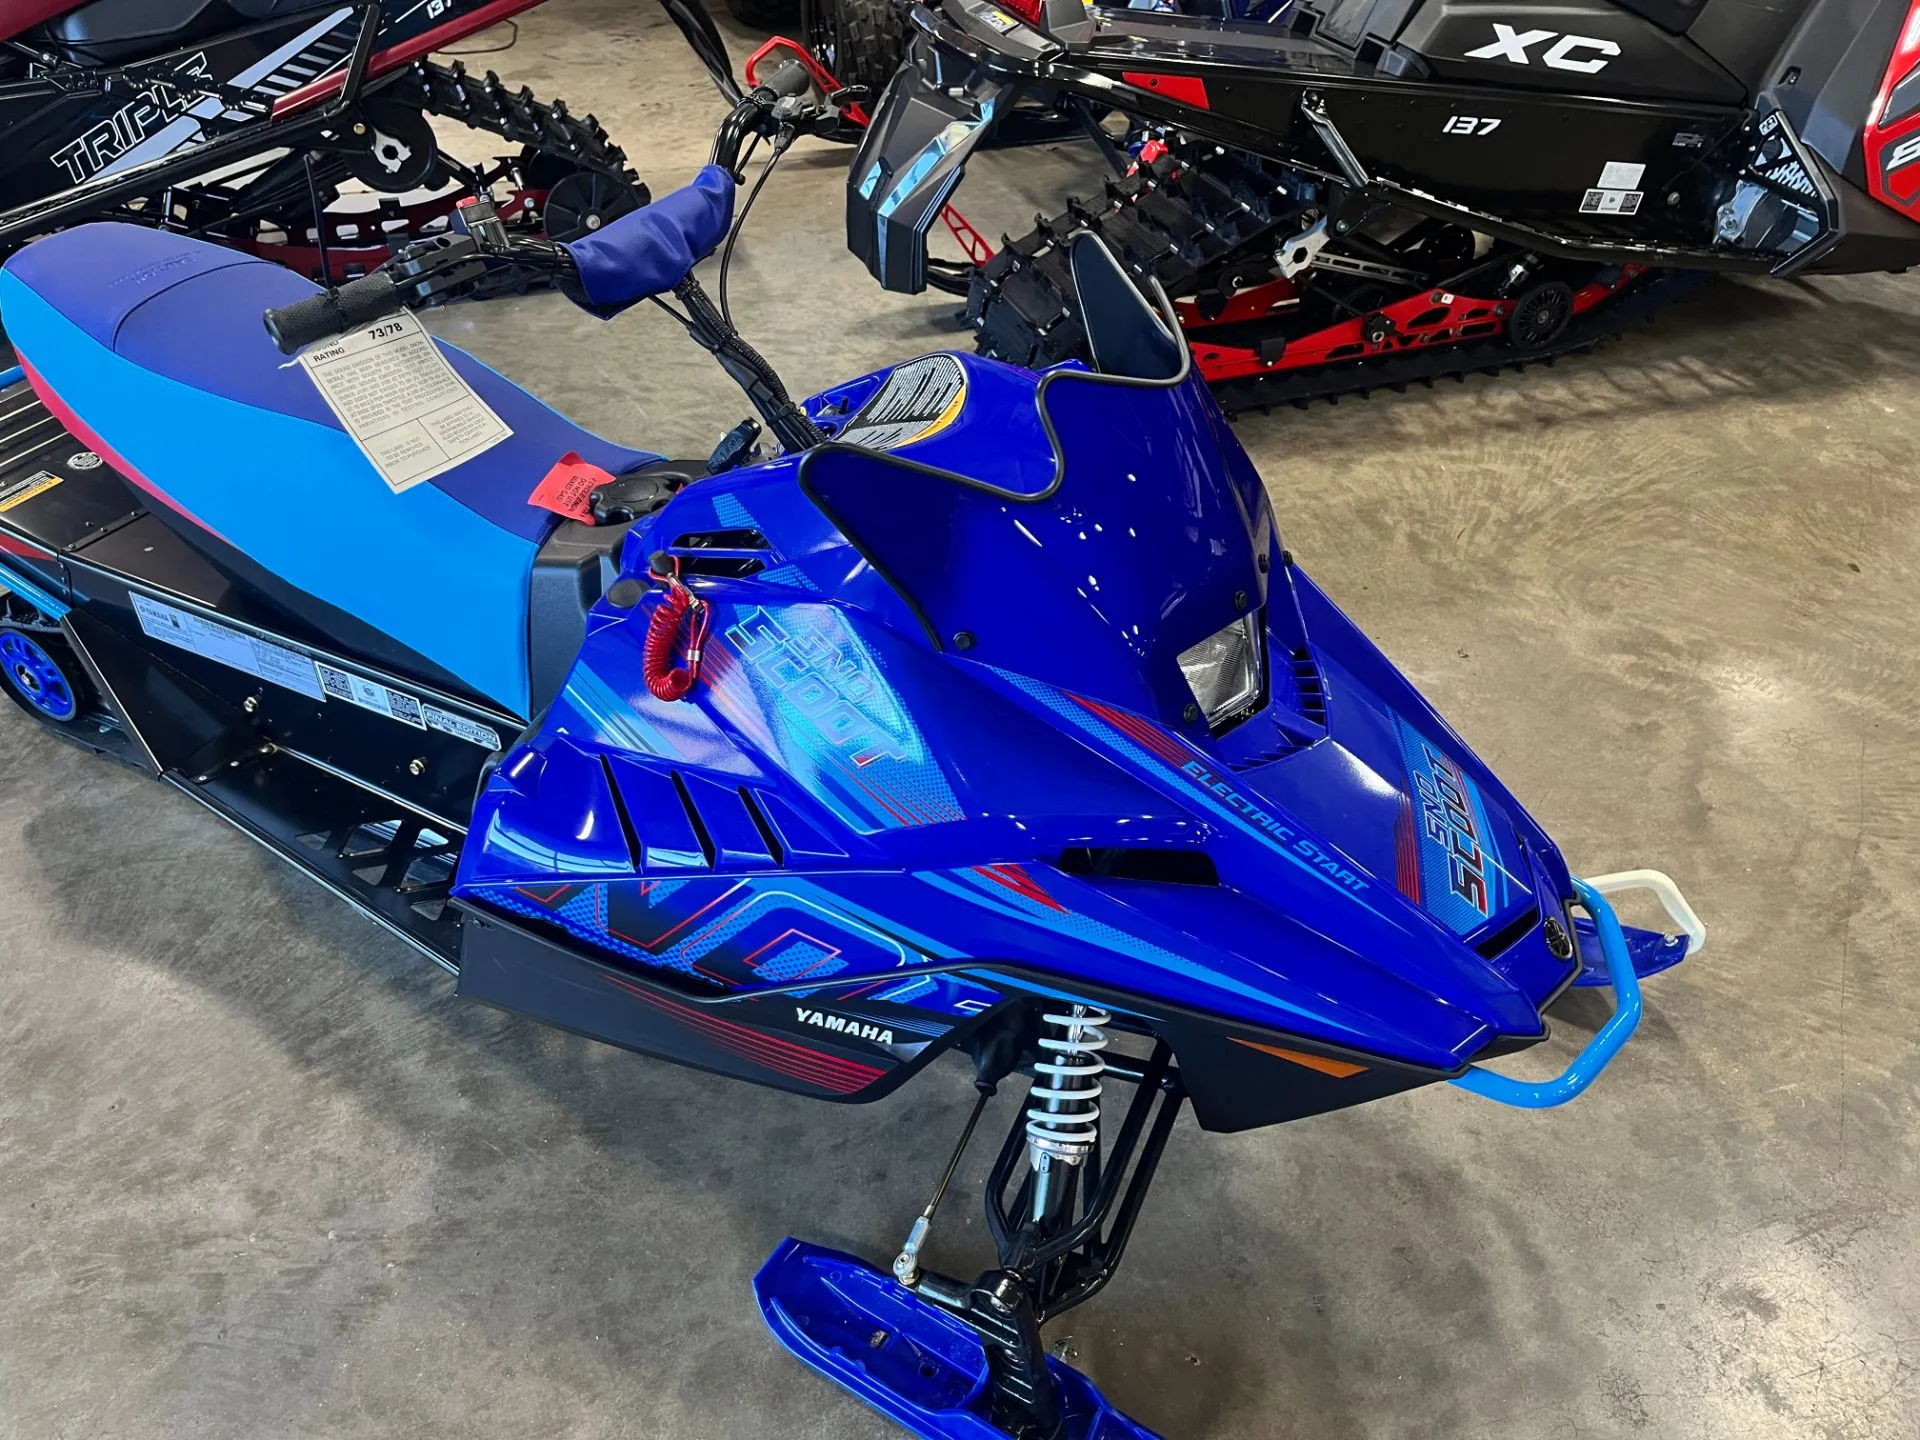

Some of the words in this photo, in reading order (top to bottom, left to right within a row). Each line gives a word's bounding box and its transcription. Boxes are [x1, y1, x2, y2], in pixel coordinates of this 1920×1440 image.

[1463, 23, 1621, 74] XC
[1442, 116, 1501, 135] 137
[368, 322, 403, 340] 73/78
[313, 347, 345, 362] RATING
[579, 478, 586, 486] DO
[725, 606, 907, 767] SCOOT
[1182, 760, 1295, 841] ELECTRIC
[1293, 839, 1370, 891] START
[1413, 770, 1450, 850] SNO
[1422, 743, 1488, 918] SCOOT
[796, 1007, 893, 1046] YAMAHA
